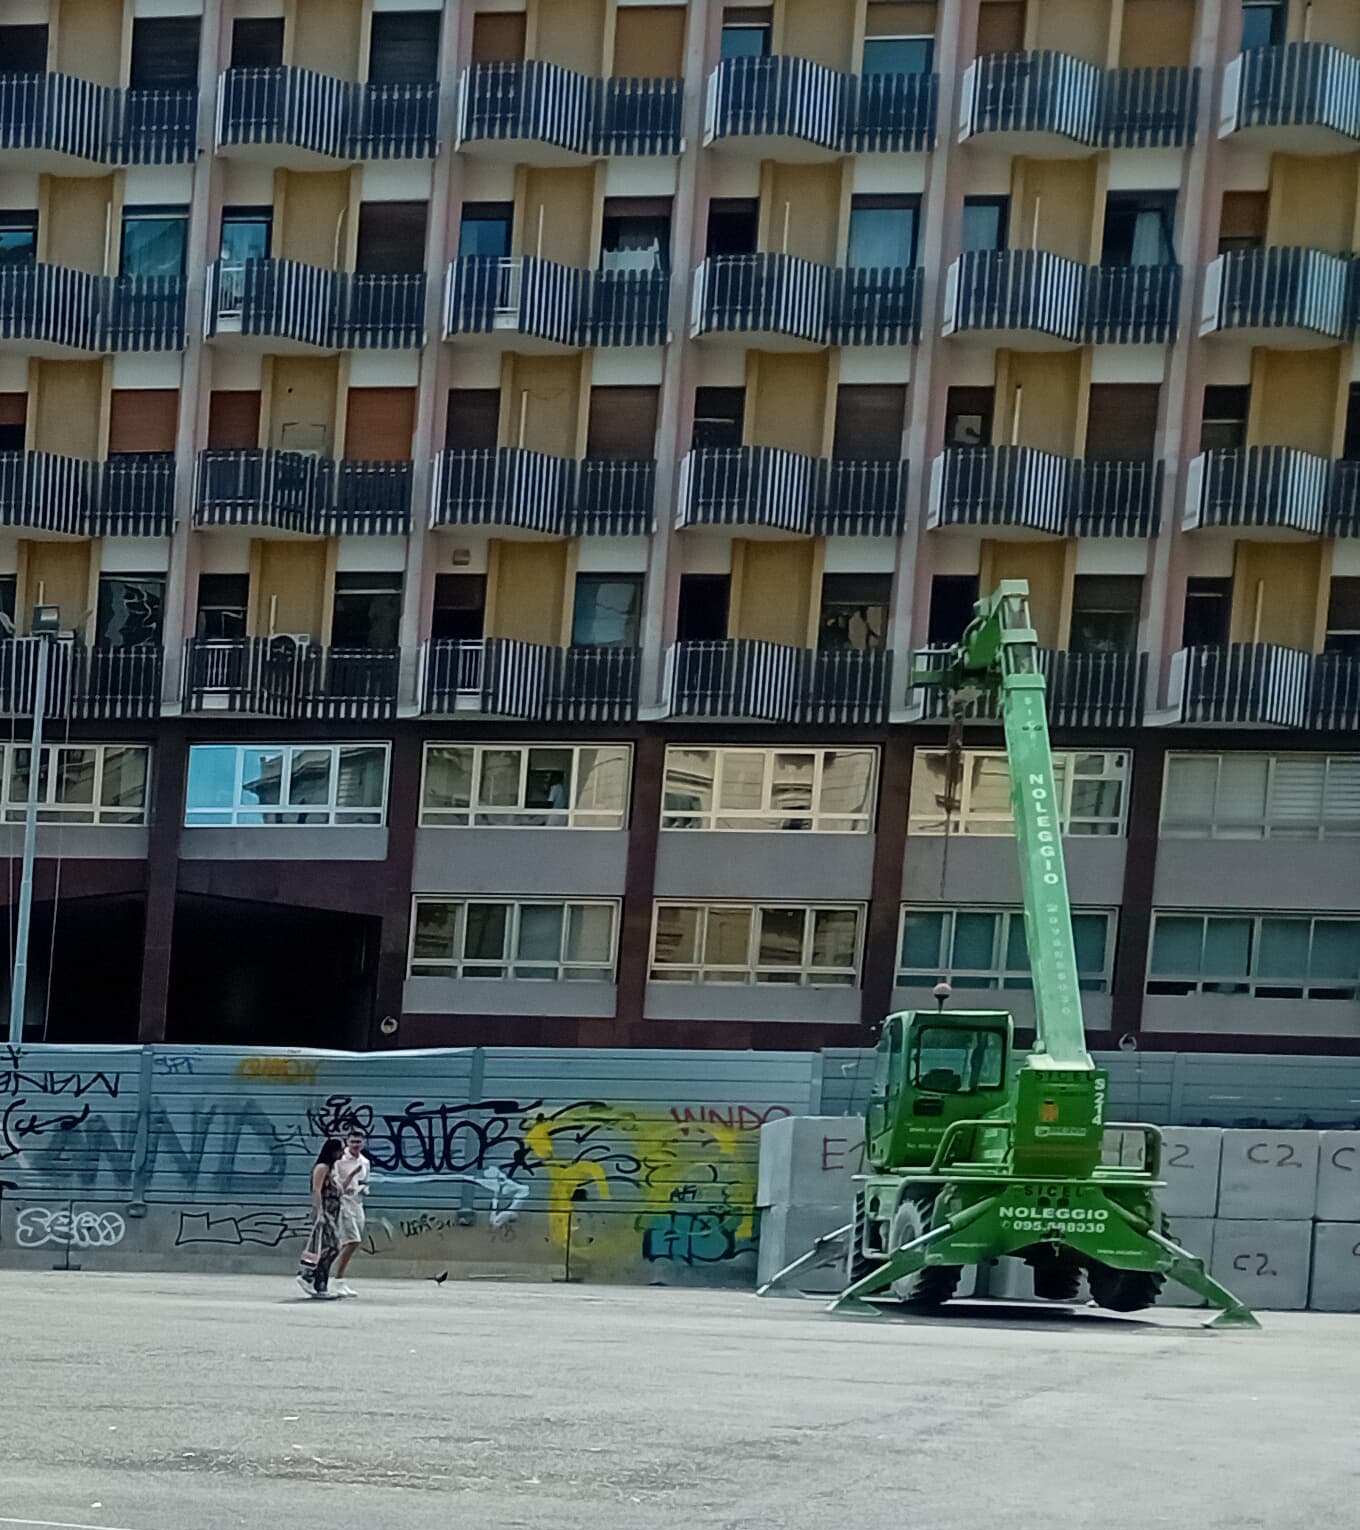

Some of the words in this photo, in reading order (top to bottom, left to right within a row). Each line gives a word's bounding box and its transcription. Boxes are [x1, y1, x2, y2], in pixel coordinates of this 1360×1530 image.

[1029, 774, 1059, 885] NOLEGGIO
[1246, 1142, 1304, 1169] C2
[998, 1206, 1110, 1220] NOLEGGIO
[1233, 1253, 1278, 1277] C2
